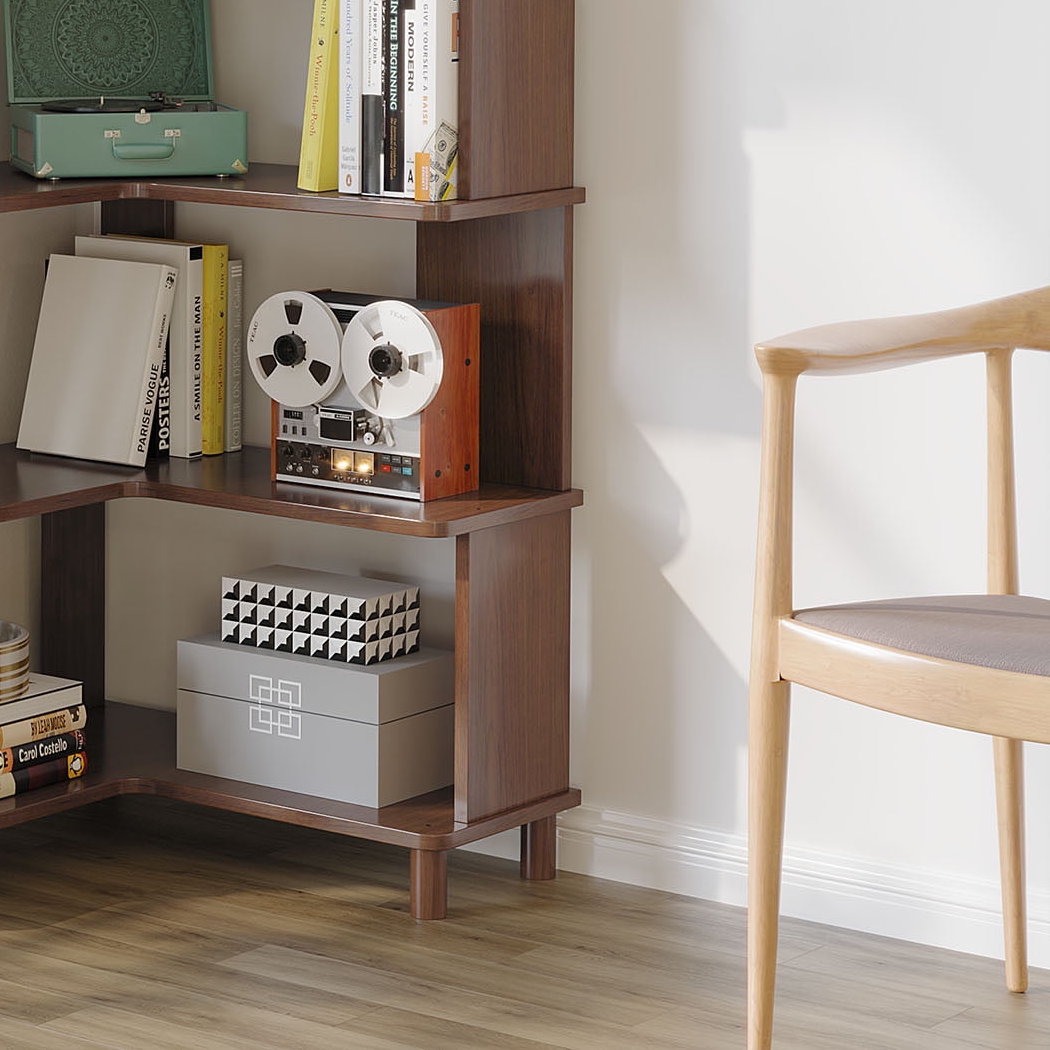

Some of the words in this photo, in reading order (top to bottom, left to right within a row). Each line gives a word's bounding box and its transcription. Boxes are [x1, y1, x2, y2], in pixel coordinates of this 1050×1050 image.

[319, 0, 327, 28] MILNE
[390, 0, 399, 14] IN
[390, 16, 398, 40] THE
[345, 38, 353, 65] Years
[407, 22, 415, 92] MODERN
[345, 68, 353, 80] of
[390, 43, 398, 111] BEGINNING
[344, 82, 353, 123] Solitude
[194, 353, 201, 371] ON
[137, 406, 152, 453] PARISE
[145, 363, 160, 406] VOGUE
[158, 376, 170, 450] POSTERS
[194, 413, 201, 421] A
[30, 721, 38, 736] BY
[18, 744, 38, 763] Carol
[38, 738, 68, 757] Costello
